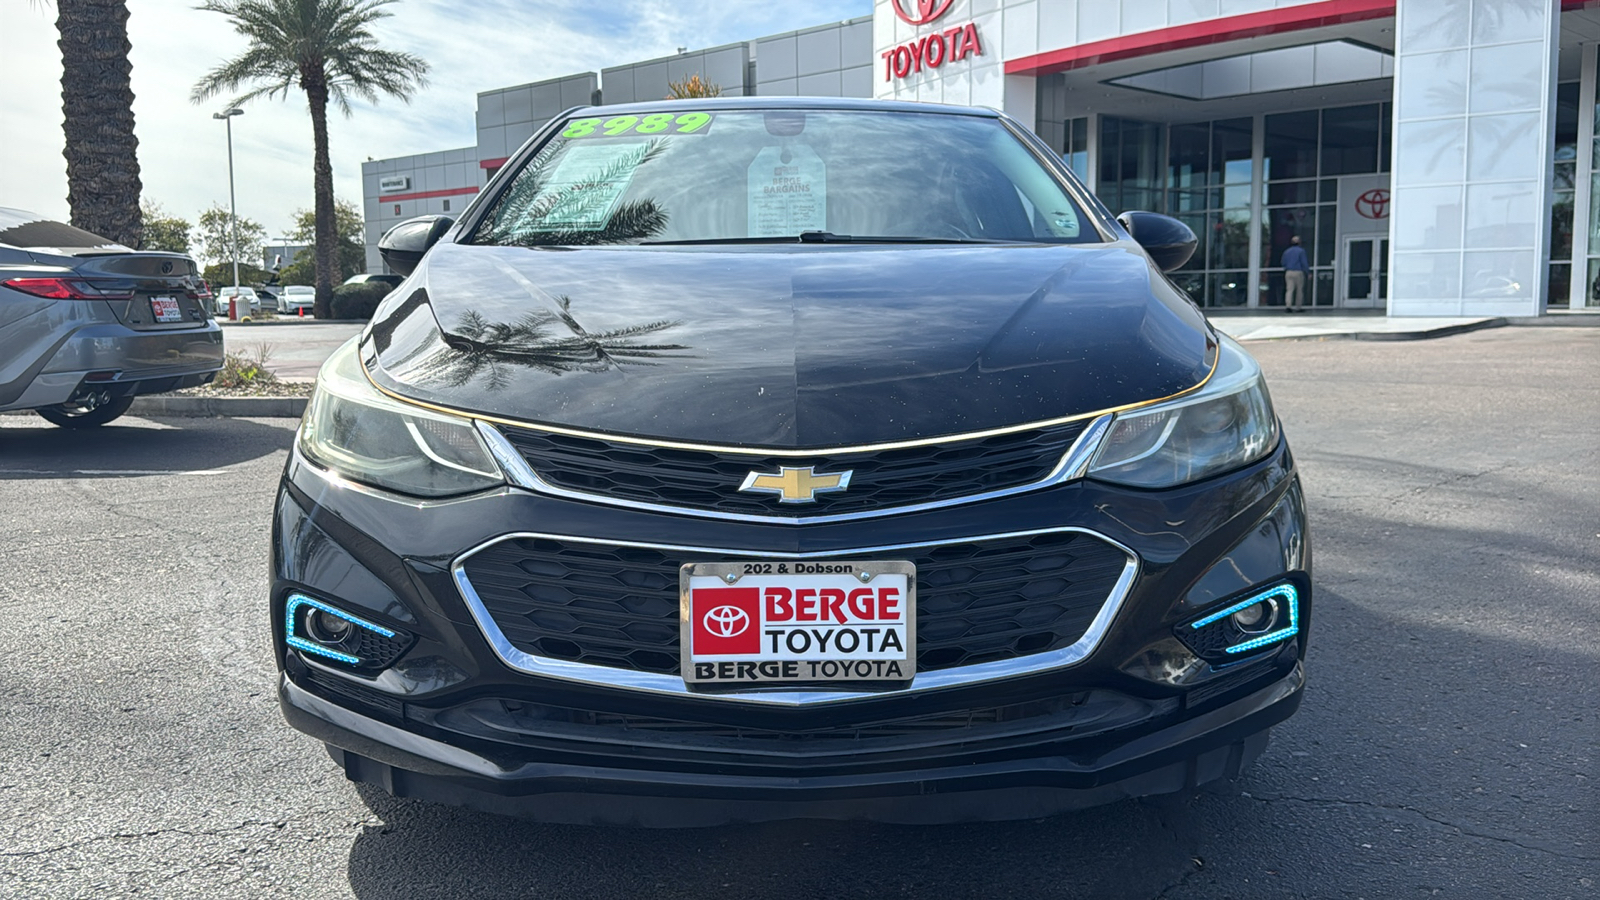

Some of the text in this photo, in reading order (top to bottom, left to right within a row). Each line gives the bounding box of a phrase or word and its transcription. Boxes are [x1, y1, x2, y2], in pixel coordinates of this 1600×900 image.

[881, 22, 982, 82] TOYOTA
[562, 112, 713, 138] 8989
[763, 185, 811, 193] BARGAINS
[772, 177, 802, 186] BERGE
[160, 301, 179, 309] BERGE
[743, 563, 853, 574] 202 & Dobson
[764, 587, 901, 625] BERGE
[765, 628, 904, 654] TOYOTA
[695, 660, 903, 680] BERGE TOYOTA
